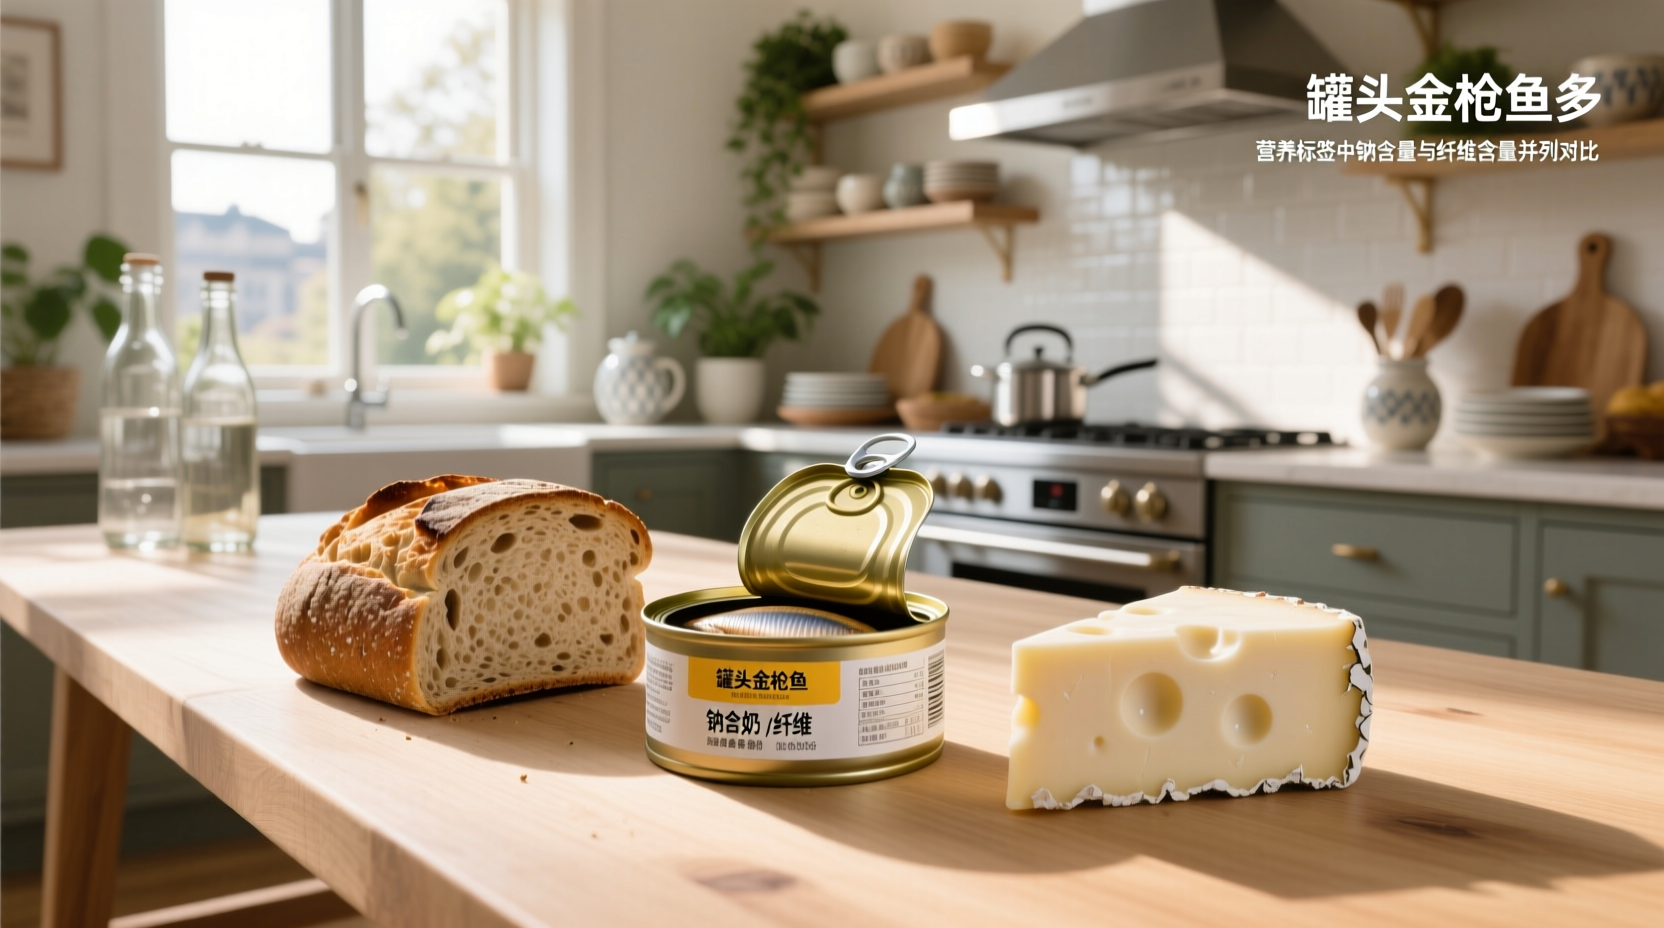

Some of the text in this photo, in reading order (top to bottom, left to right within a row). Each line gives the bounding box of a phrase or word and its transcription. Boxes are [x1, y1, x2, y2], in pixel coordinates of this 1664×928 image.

[716, 667, 808, 691] 罐头金枪鱼
